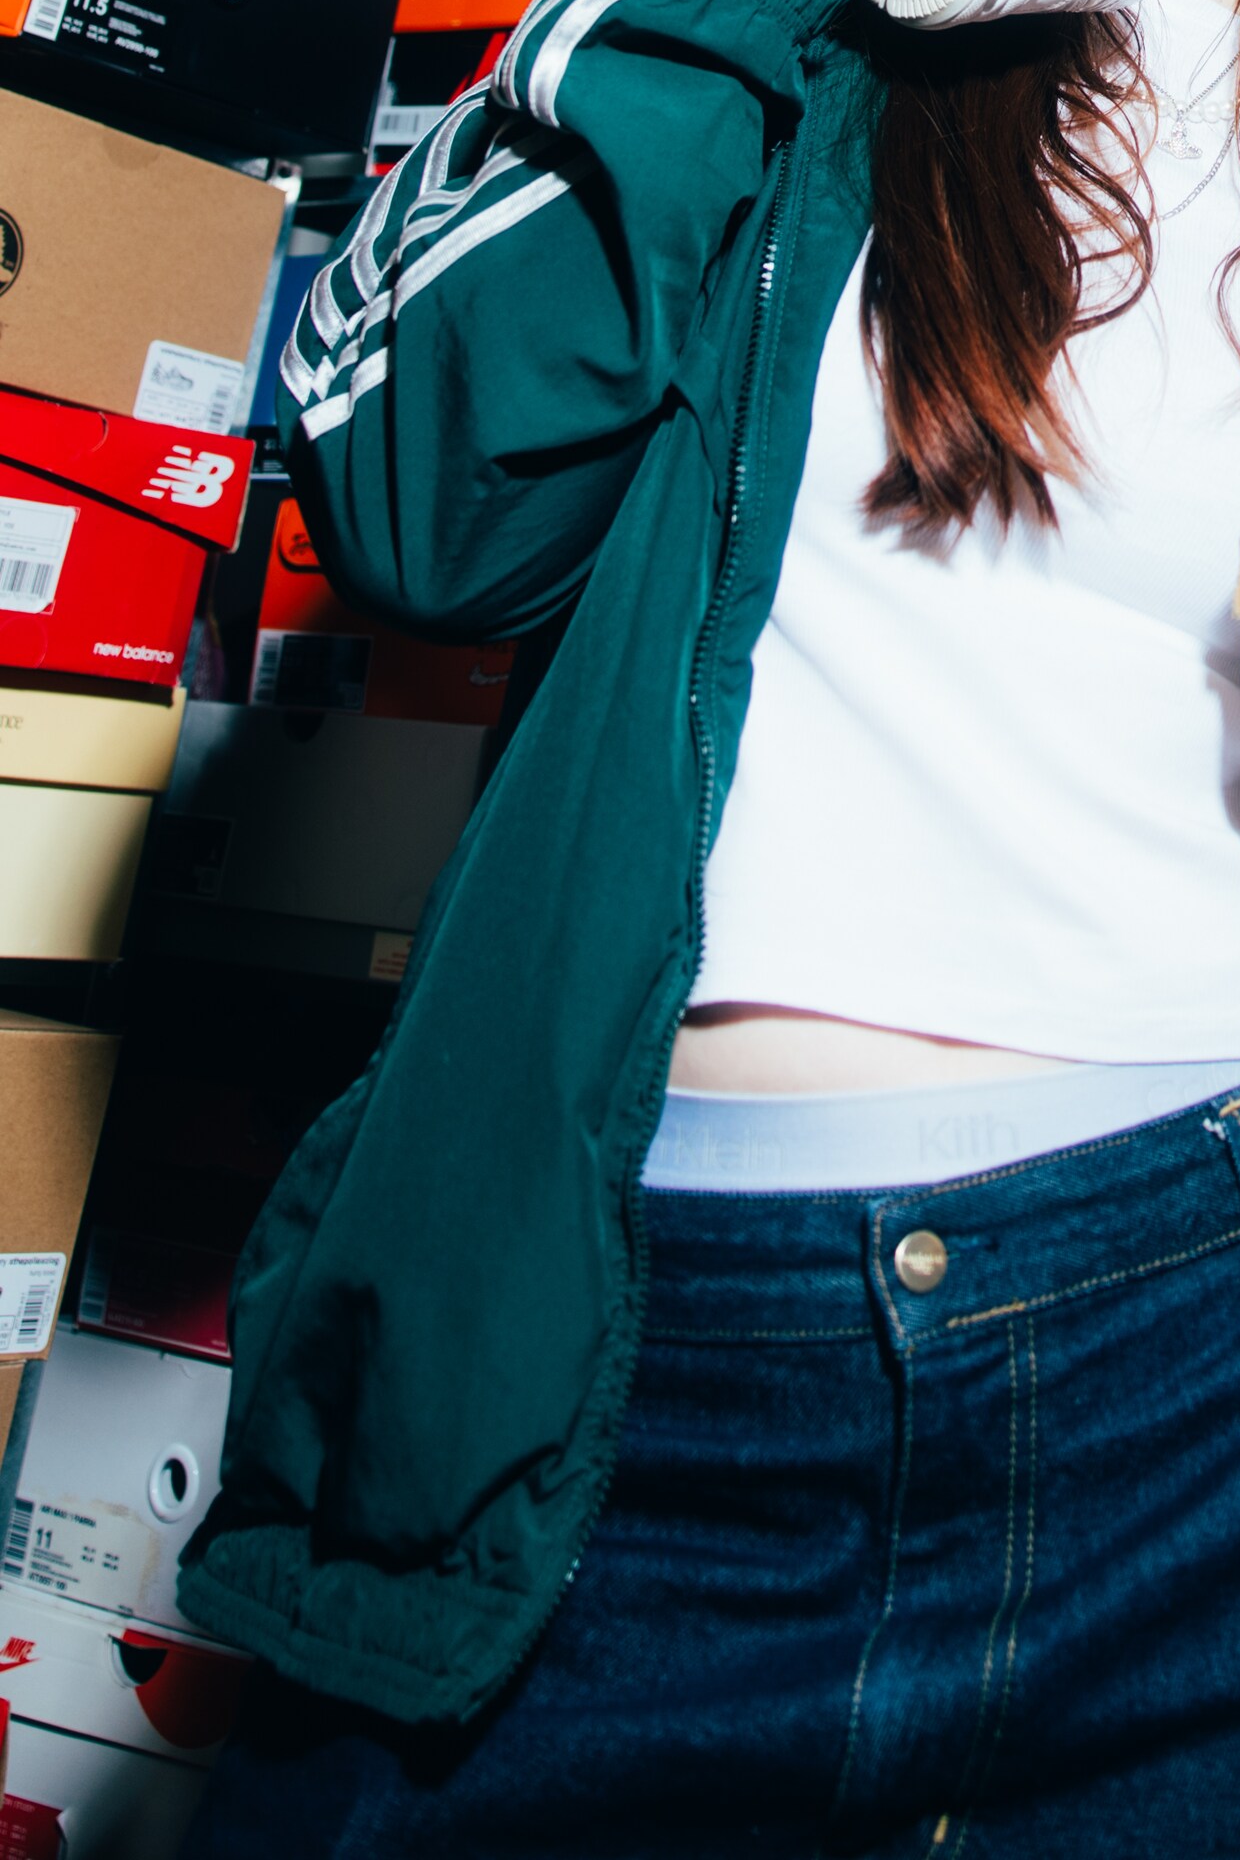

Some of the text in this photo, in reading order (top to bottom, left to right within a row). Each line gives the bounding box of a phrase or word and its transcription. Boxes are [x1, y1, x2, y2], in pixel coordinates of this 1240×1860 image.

[93, 641, 174, 664] new balance
[36, 1527, 53, 1550] 11
